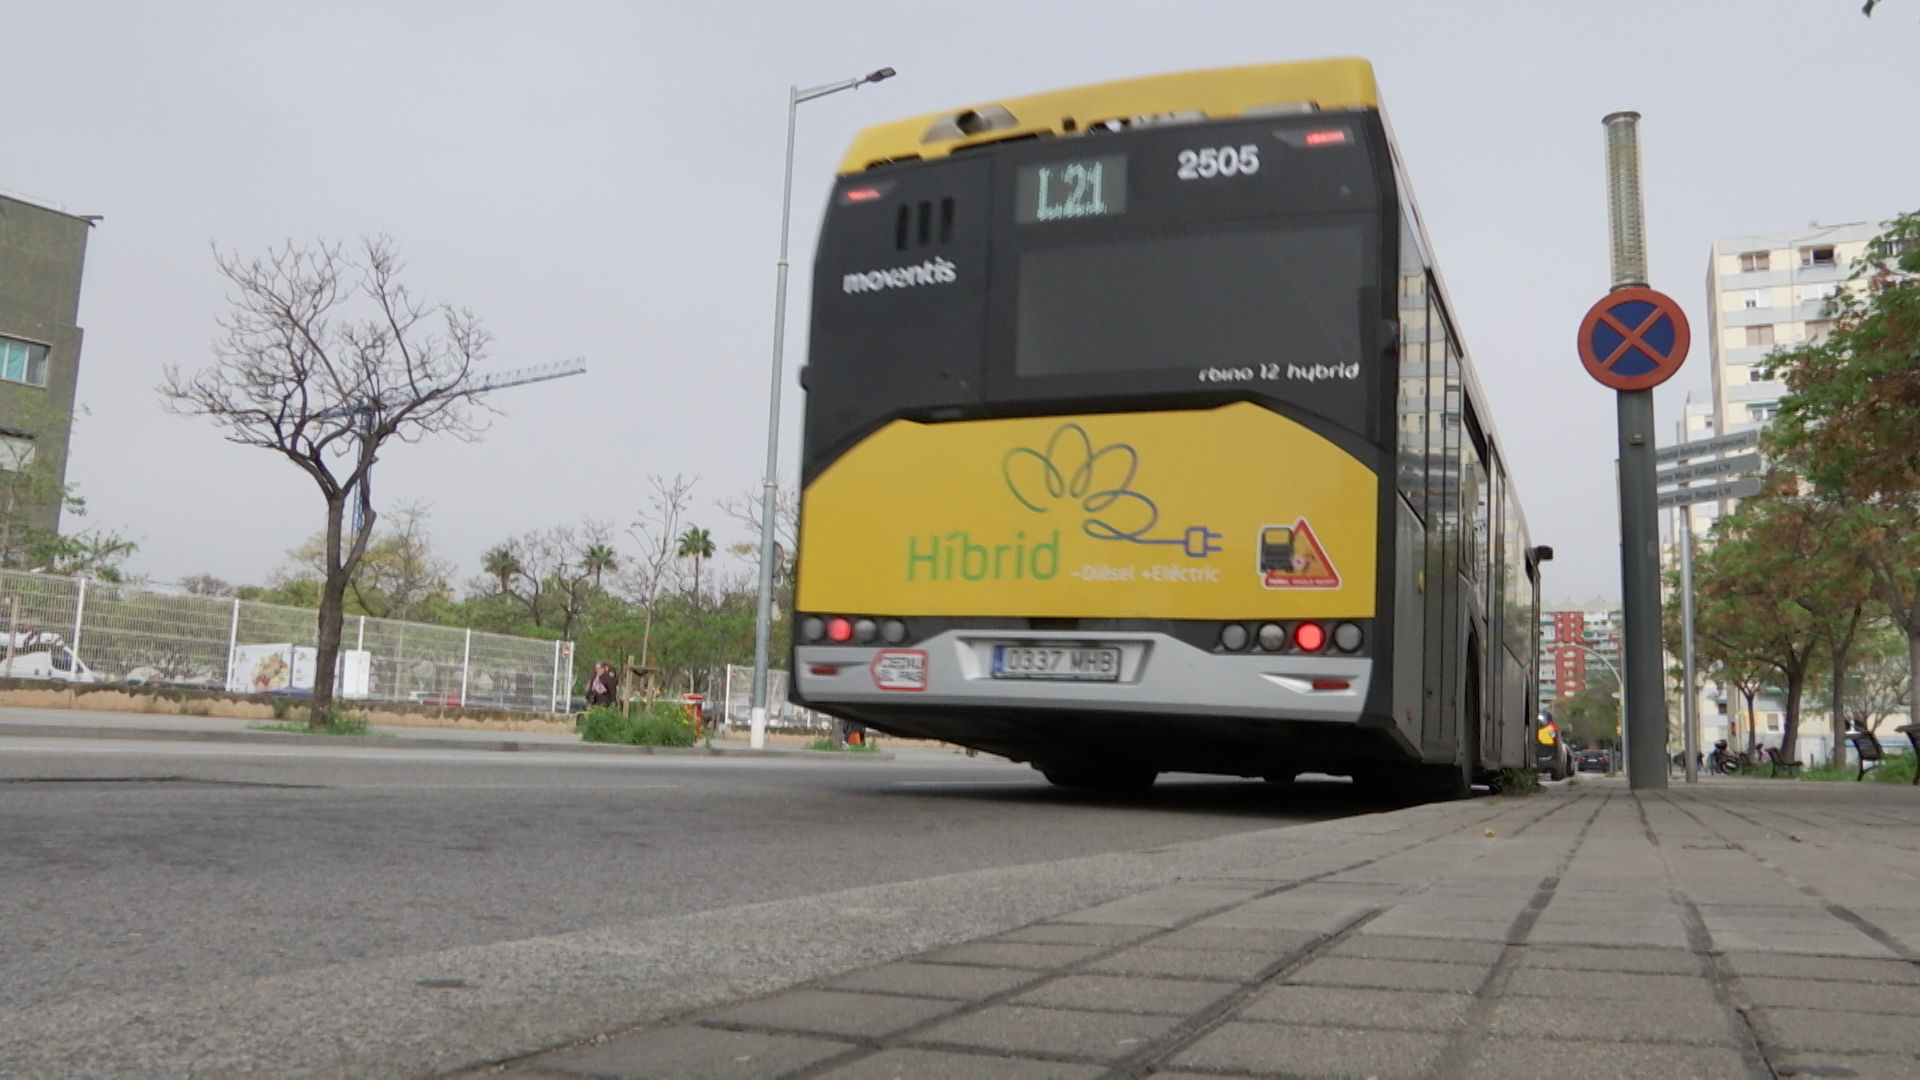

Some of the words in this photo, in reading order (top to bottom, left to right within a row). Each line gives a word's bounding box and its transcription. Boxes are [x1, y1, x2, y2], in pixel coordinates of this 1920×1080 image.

[1176, 143, 1260, 181] 2505
[1037, 161, 1107, 222] L21
[1259, 362, 1280, 381] 12
[1286, 360, 1360, 384] hybrid
[906, 530, 1060, 582] Híbrid
[1007, 648, 1063, 672] 0337
